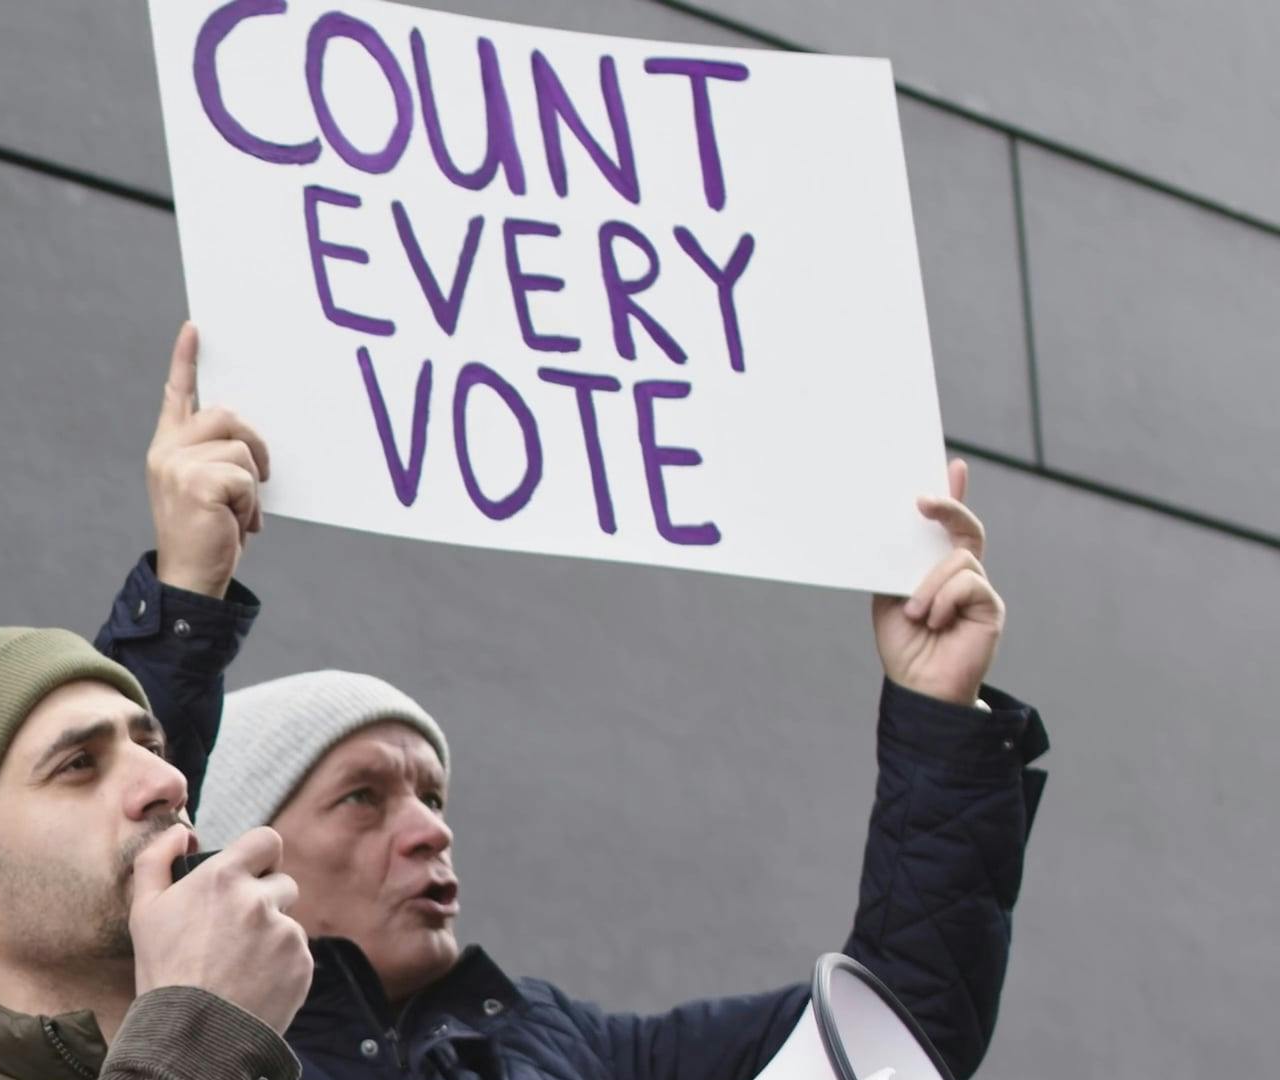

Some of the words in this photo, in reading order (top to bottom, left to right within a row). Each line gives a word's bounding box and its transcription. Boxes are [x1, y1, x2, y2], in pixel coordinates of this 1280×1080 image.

[194, 0, 750, 211] COUNT
[303, 184, 755, 373] EVERY
[356, 347, 722, 546] VOTE
